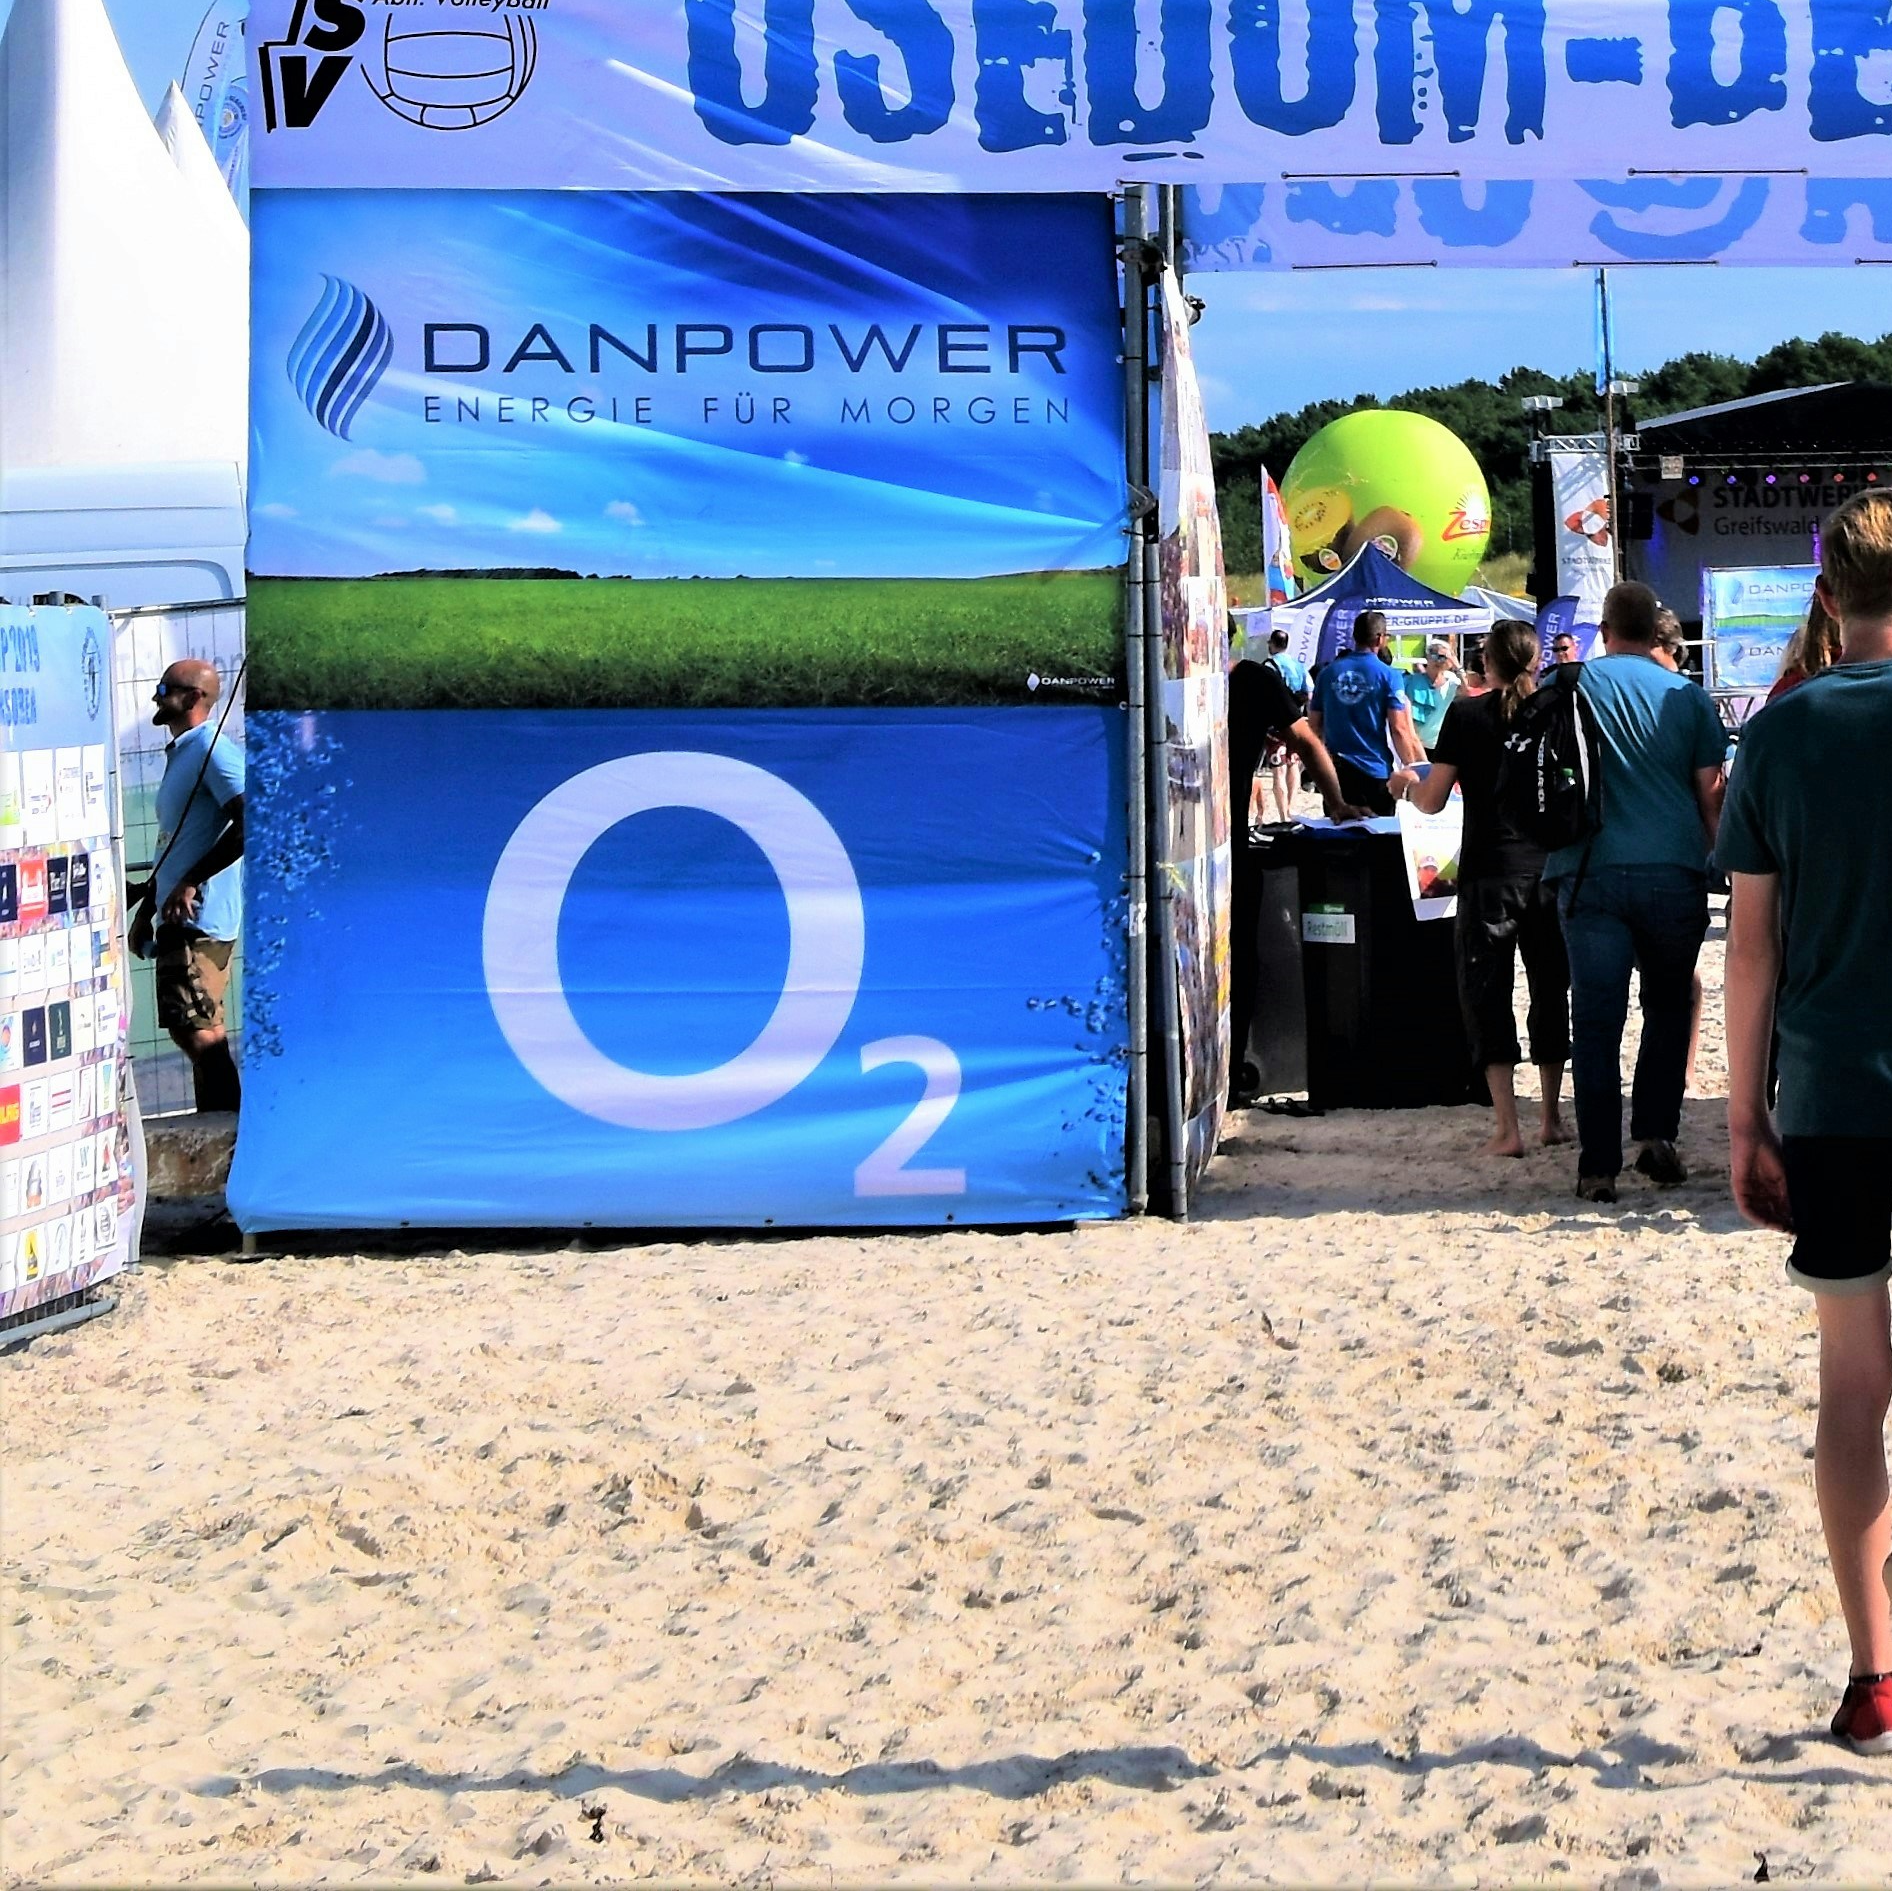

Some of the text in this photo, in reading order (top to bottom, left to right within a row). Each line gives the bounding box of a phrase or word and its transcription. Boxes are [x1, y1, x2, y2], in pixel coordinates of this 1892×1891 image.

[195, 20, 230, 130] POWER
[424, 322, 1068, 374] DANPOWER
[425, 391, 1070, 425] ENERGIE FÜR MORGEN
[1714, 516, 1820, 535] Greifswald
[1297, 614, 1315, 664] OWER
